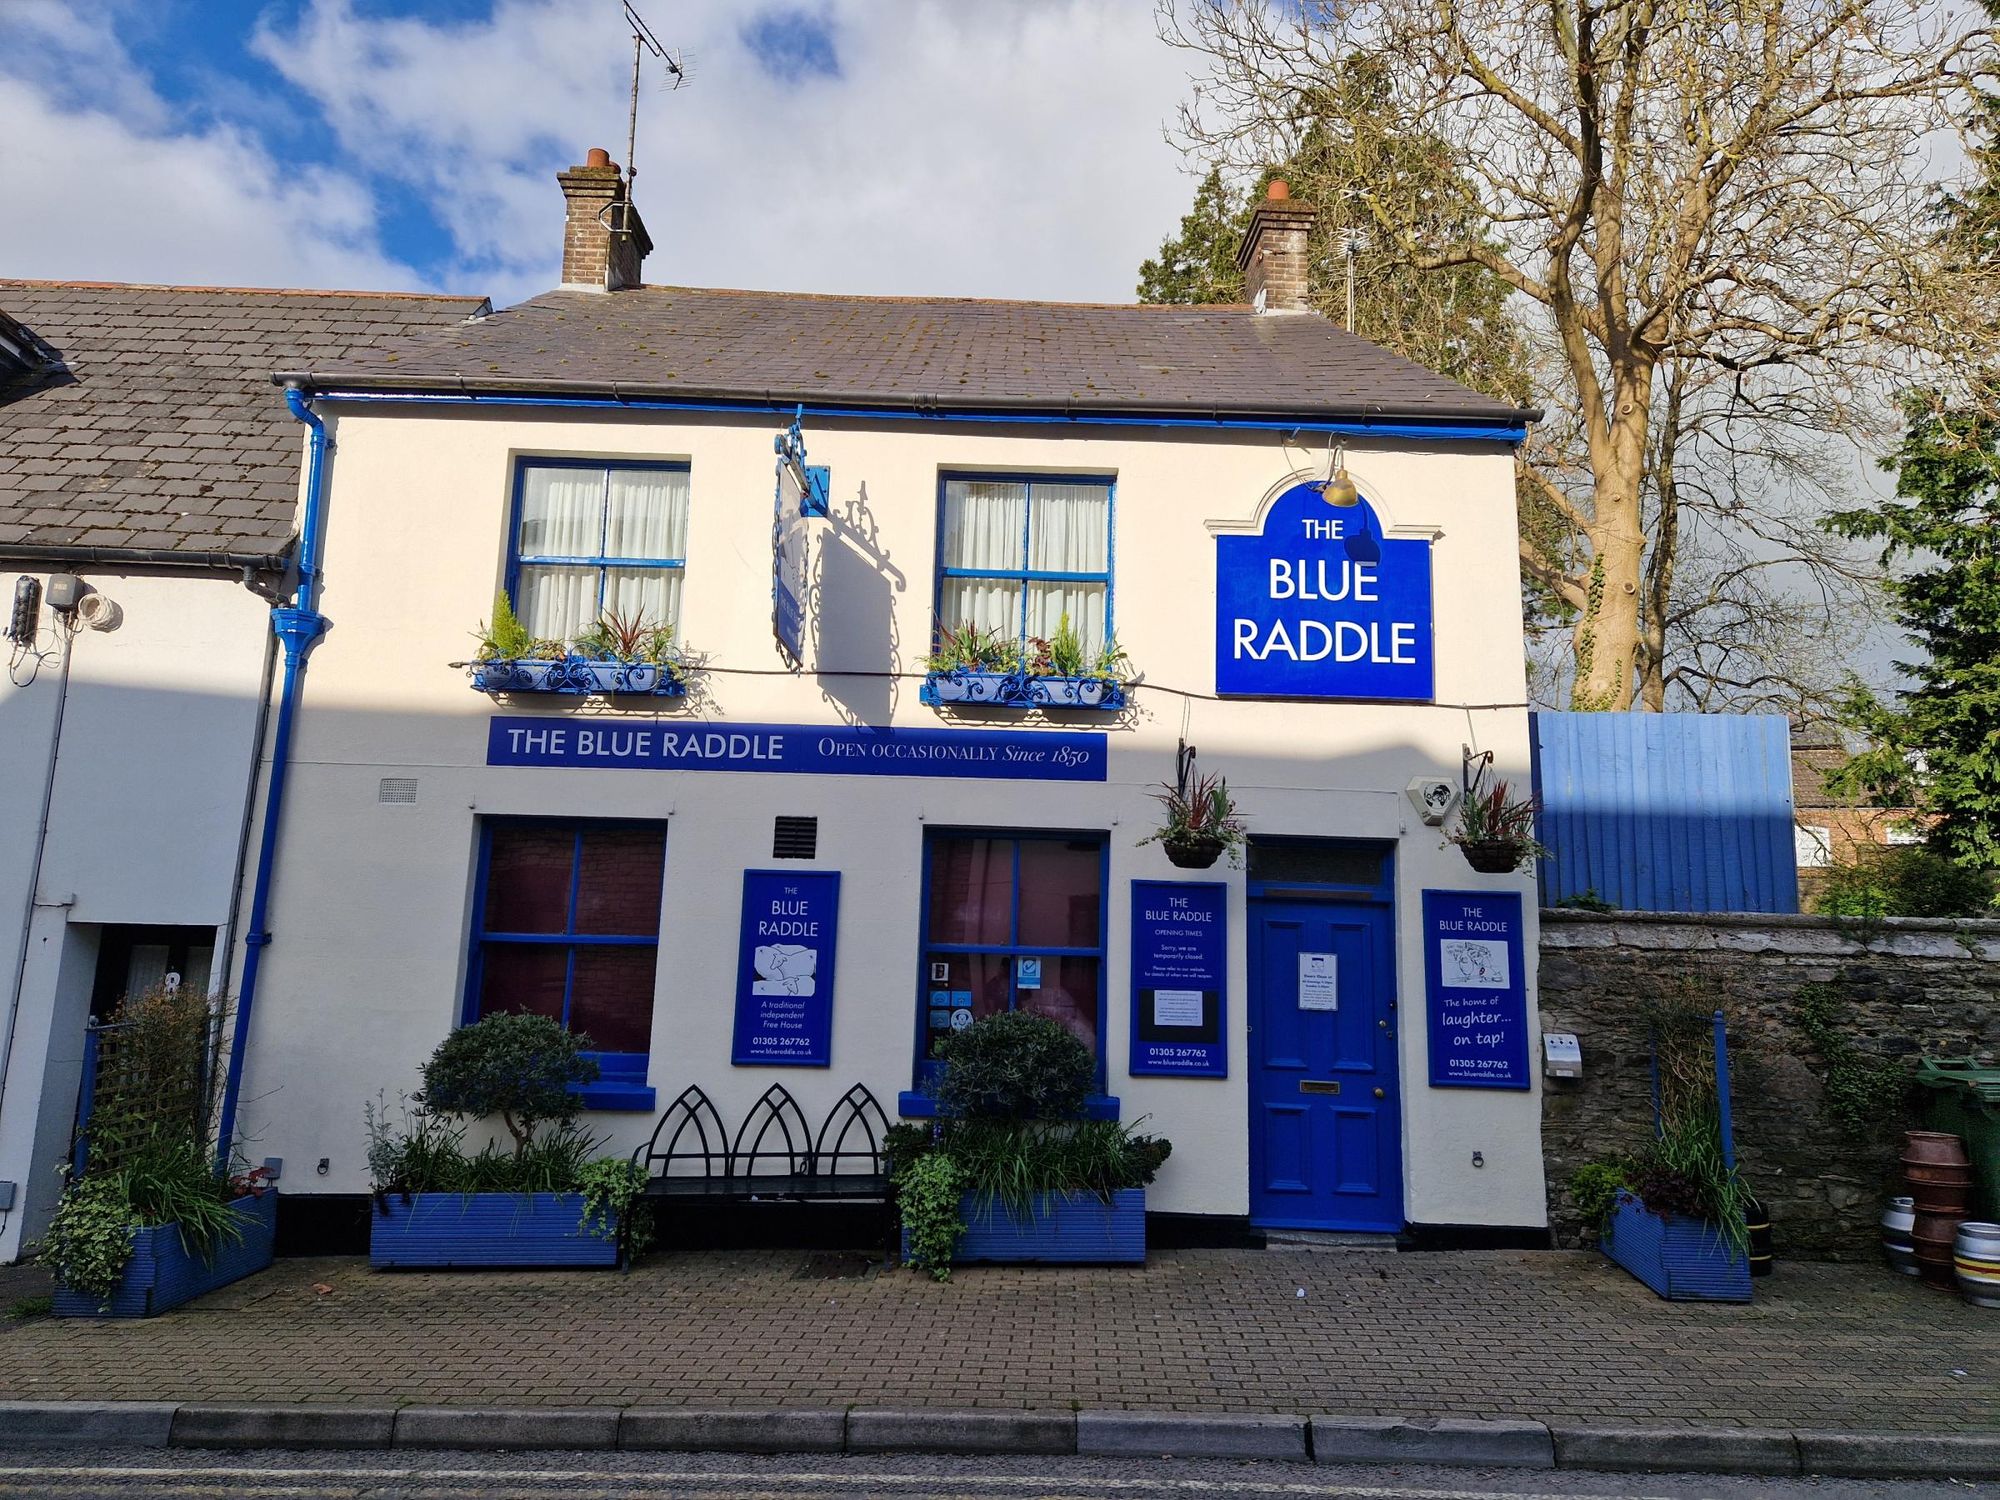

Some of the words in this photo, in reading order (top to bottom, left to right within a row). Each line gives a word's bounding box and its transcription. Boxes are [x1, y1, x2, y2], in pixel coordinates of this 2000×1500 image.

[1302, 519, 1344, 540] THE
[1269, 558, 1379, 602] BLUE
[1234, 618, 1416, 664] RADDLE
[507, 729, 566, 755] THE
[576, 730, 651, 757] BLUE
[662, 732, 784, 760] RADDLE
[871, 743, 1000, 761] OCCASIONALLY
[1001, 745, 1046, 762] Since
[1051, 745, 1090, 768] 1850
[784, 886, 798, 895] THE
[771, 900, 809, 916] BLUE
[1169, 897, 1189, 908] THE
[1145, 910, 1170, 920] BLUE
[1173, 911, 1212, 922] RADDLE
[1462, 907, 1483, 918] THE
[758, 921, 819, 937] RADDLE
[1439, 920, 1464, 931] BLUE
[1467, 921, 1508, 932] RADDLE
[1161, 944, 1178, 952] Sorry,
[769, 1001, 806, 1009] traditional
[1444, 999, 1460, 1007] The
[1462, 998, 1487, 1006] home
[1489, 995, 1499, 1005] of
[760, 1010, 805, 1020] independent
[763, 1020, 779, 1028] Free
[780, 1021, 803, 1029] House
[752, 1037, 778, 1045] 01305
[780, 1037, 810, 1046] 267762
[1453, 1036, 1471, 1046] on
[1476, 1031, 1505, 1048] tap!
[1150, 1048, 1175, 1056] 01305
[1176, 1048, 1207, 1057] 267762
[1449, 1059, 1475, 1068] 01305
[1477, 1060, 1508, 1069] 267762
[1448, 1070, 1512, 1078] www.blueraddle.co.uk
